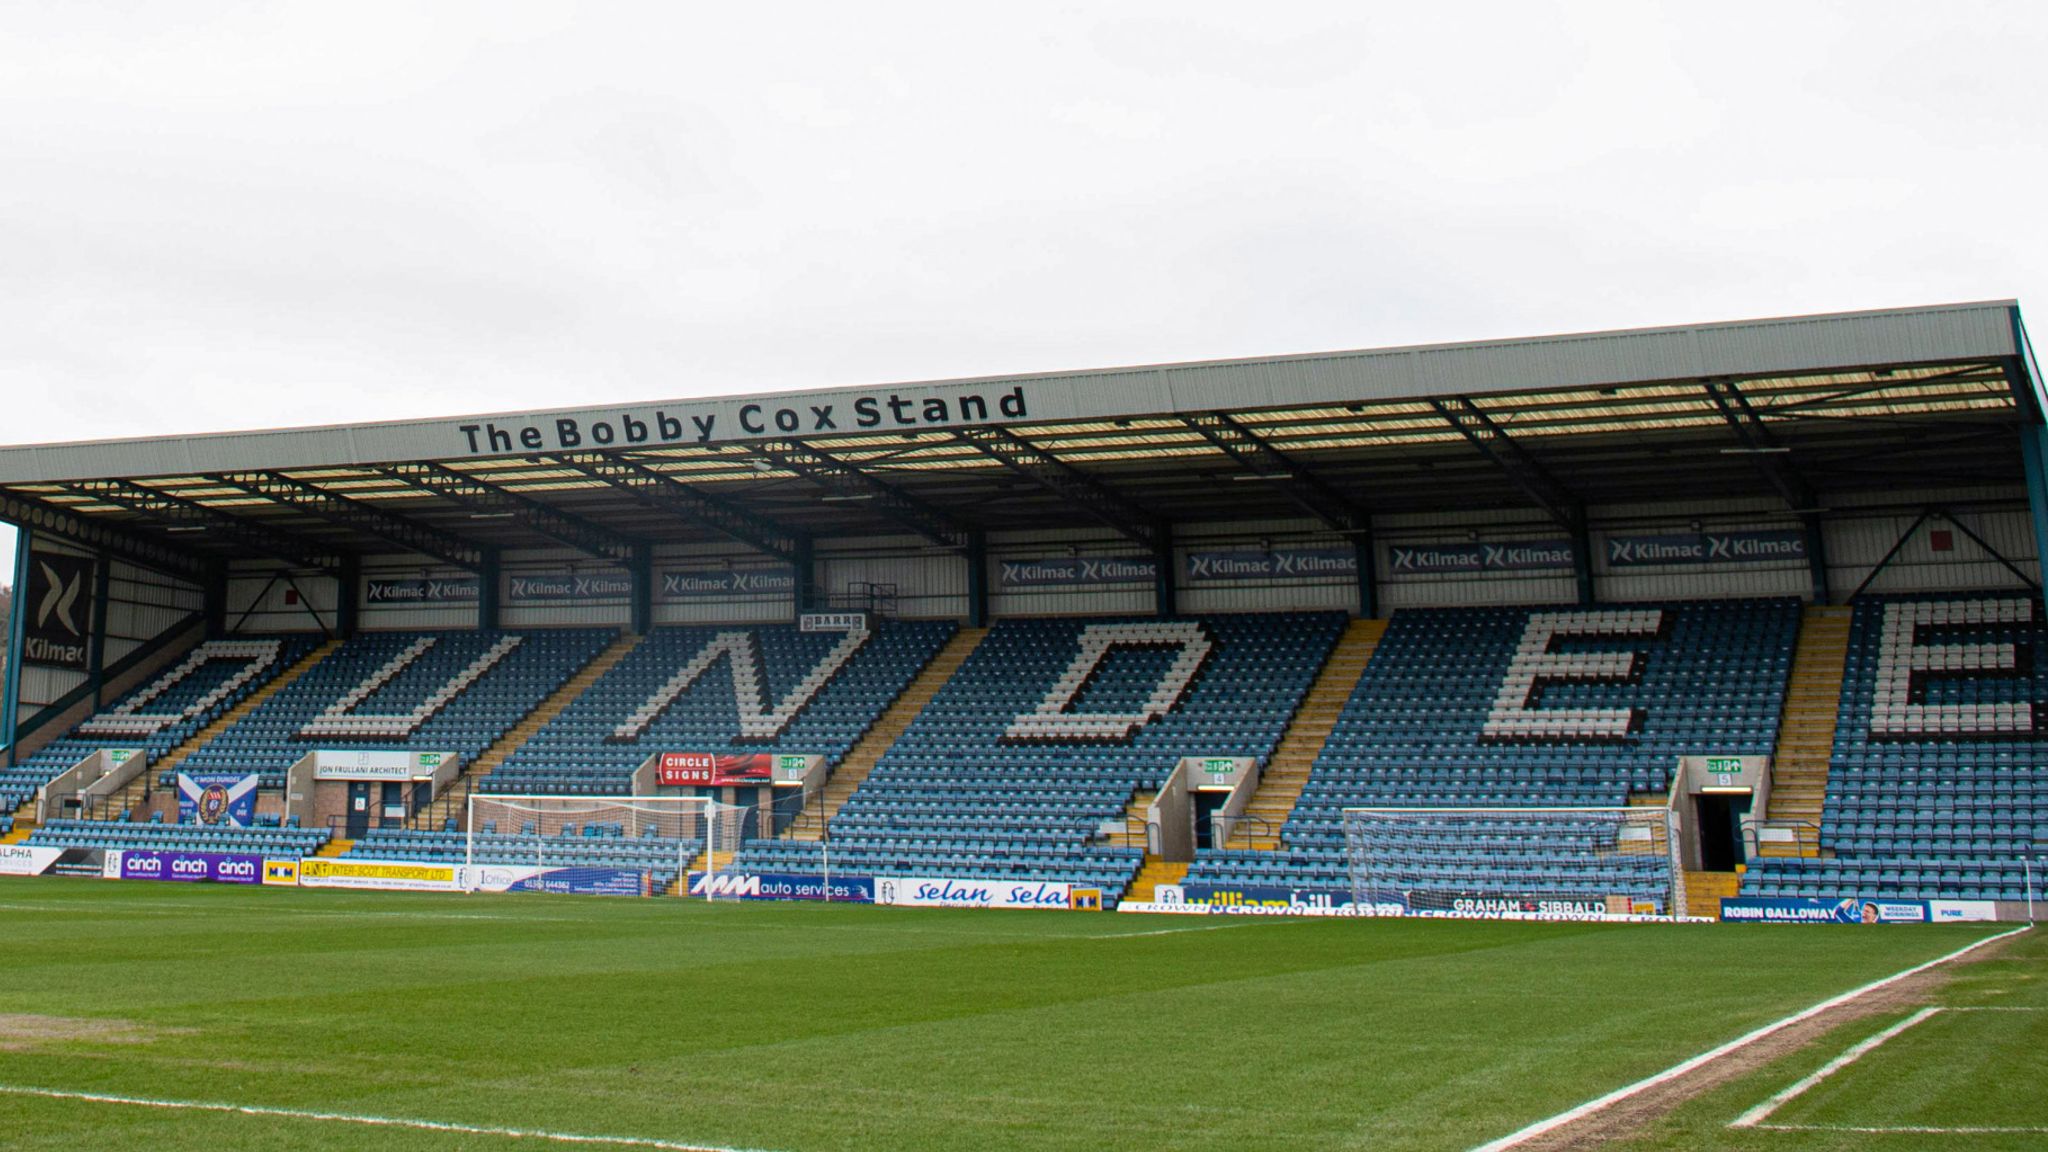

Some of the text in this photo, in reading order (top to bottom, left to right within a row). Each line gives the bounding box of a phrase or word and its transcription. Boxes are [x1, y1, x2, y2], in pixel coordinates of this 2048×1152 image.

[460, 386, 1028, 453] The Bobby Cox Stand
[1507, 546, 1573, 563] Kilmac
[1635, 542, 1702, 560] Kilmac
[1732, 538, 1803, 556] Kilmac
[1211, 558, 1270, 574] Kilmac
[1296, 554, 1356, 571] Kilmac
[1415, 550, 1479, 567] Kilmac
[1021, 565, 1075, 580] Kilmac
[1100, 562, 1156, 578] Kilmac
[443, 583, 479, 597] Kilma
[527, 581, 570, 595] Kilmac
[681, 576, 728, 590] Kilmac
[383, 585, 424, 598] Kilmac
[815, 615, 851, 625] BARR
[666, 757, 709, 767] CIRCLE
[319, 766, 333, 774] JON
[369, 766, 407, 775] ARCHITECT
[666, 770, 709, 780] SIGNS
[127, 853, 161, 871] cinch
[172, 855, 207, 874] cinch
[218, 857, 254, 876] cinch
[269, 867, 293, 878] MKM
[382, 867, 429, 879] TRANSPORT
[431, 869, 445, 880] LTD
[761, 882, 791, 895] auto
[795, 883, 849, 897] services
[1226, 905, 1302, 915] CROWN
[1453, 898, 1606, 914] GRAHAM SIBBALD
[1723, 906, 1837, 919] ROBIN GALLOWAY
[1940, 909, 1963, 917] PURE
